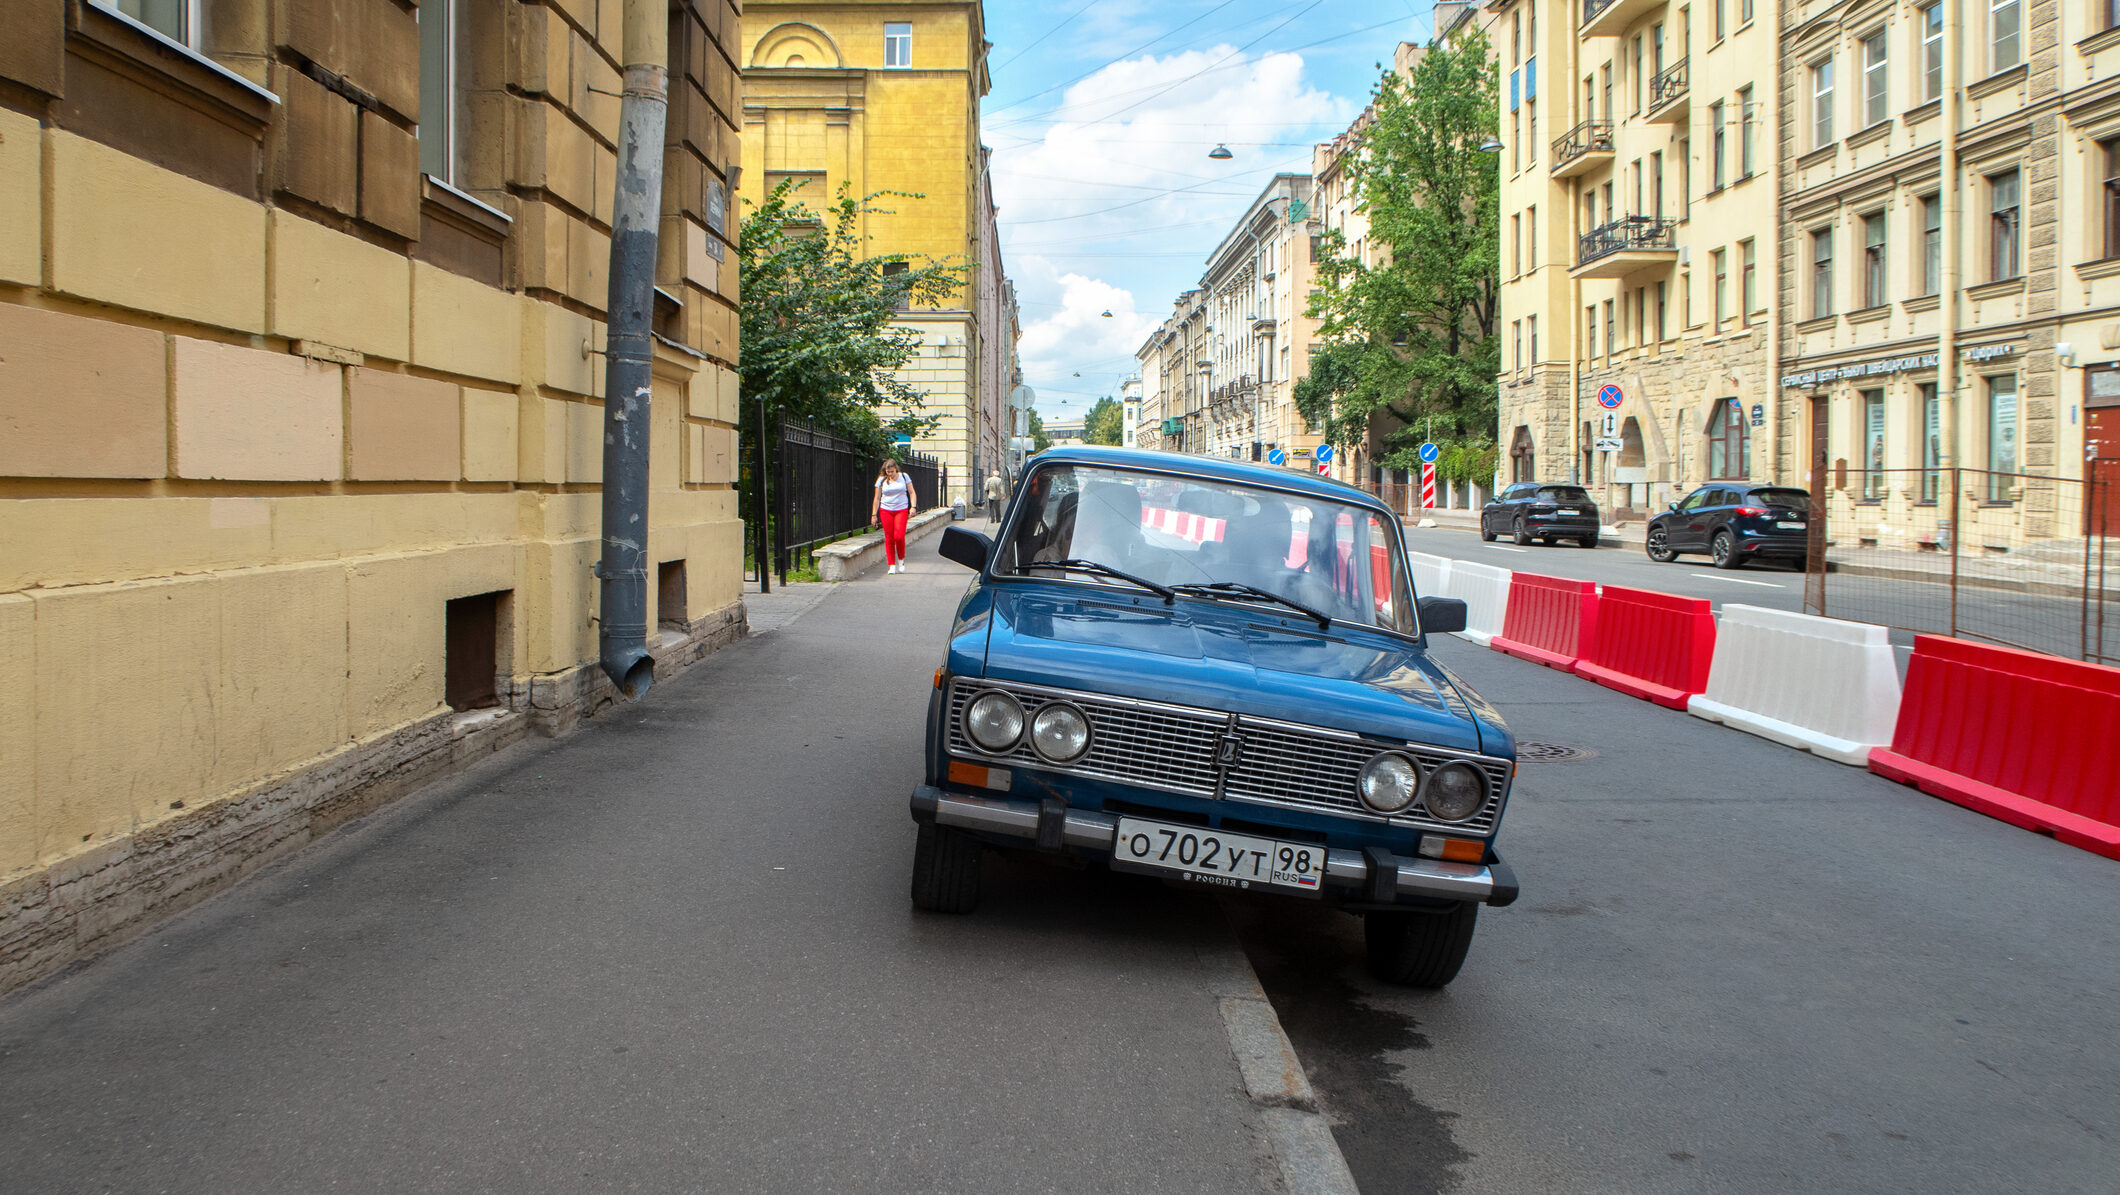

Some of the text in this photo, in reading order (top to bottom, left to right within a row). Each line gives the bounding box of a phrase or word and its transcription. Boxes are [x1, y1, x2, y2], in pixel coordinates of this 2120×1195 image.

[1279, 847, 1311, 873] 98
[1195, 874, 1237, 887] РОССИЯ
[1273, 871, 1298, 883] RUS
